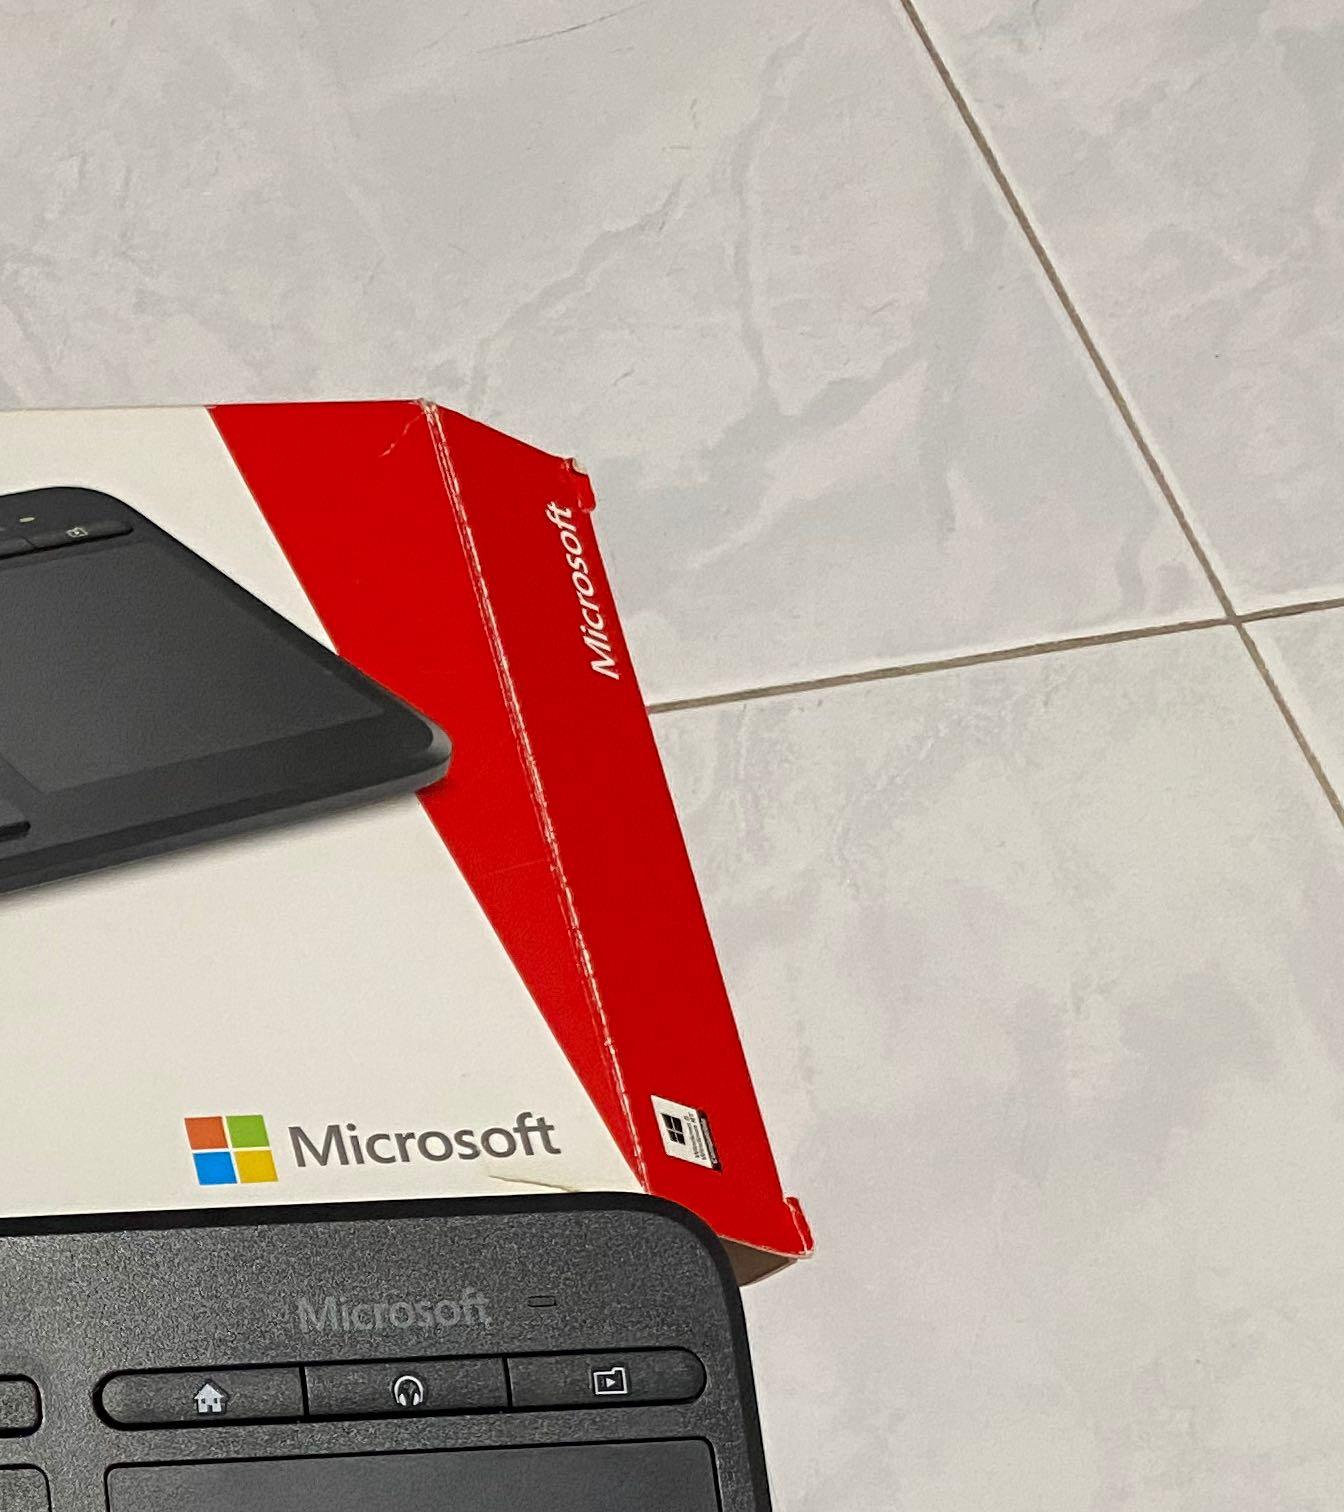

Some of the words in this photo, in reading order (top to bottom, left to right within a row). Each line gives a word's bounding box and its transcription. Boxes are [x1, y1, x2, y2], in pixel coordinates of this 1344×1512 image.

[545, 501, 620, 681] Microsoft
[288, 1112, 562, 1168] Microsoft
[297, 1288, 491, 1333] Microsoft
